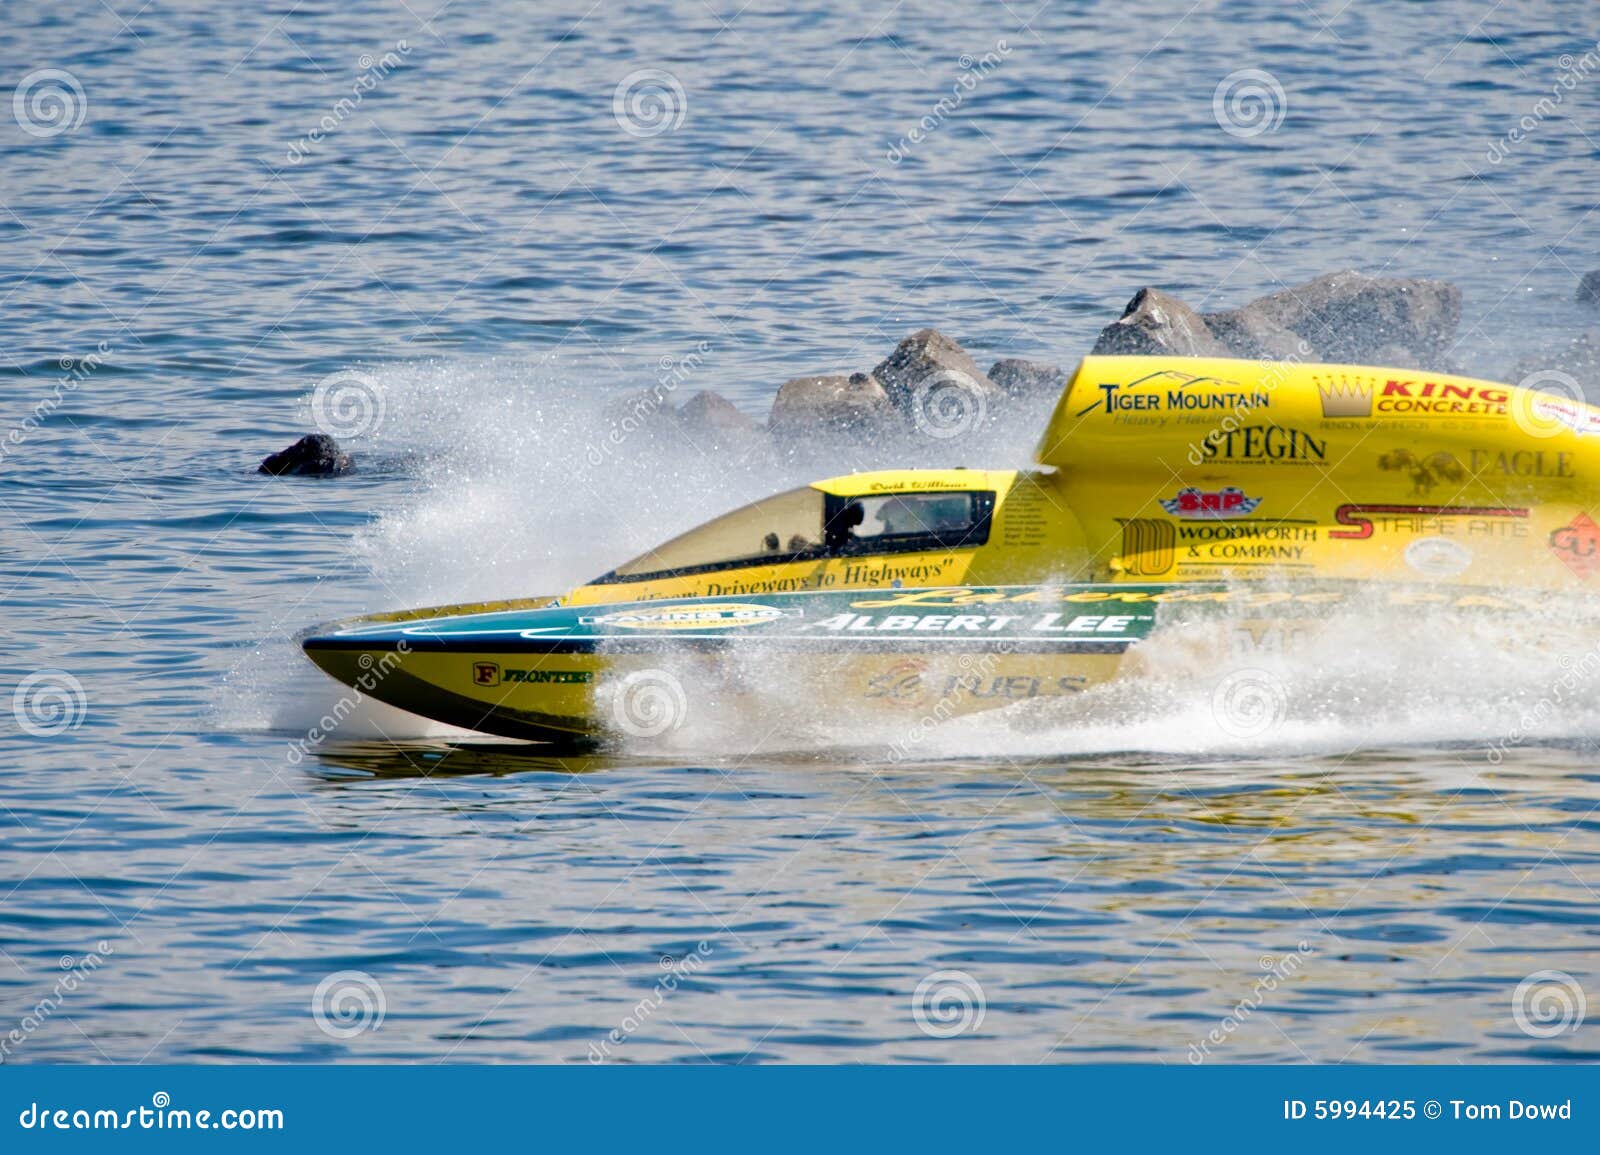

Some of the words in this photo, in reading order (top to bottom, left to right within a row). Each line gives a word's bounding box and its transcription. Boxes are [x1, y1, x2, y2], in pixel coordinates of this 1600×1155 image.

[1099, 384, 1160, 413] TIGER
[1168, 391, 1269, 410] MOUNTAIN
[1381, 379, 1509, 402] KING
[1377, 399, 1508, 415] CONCRETE
[1202, 424, 1327, 459] STEGIN
[1470, 447, 1576, 477] EAGLE
[1179, 526, 1317, 541] WOODWORTH
[1187, 544, 1200, 557] &
[1209, 544, 1304, 559] COMPANY
[706, 574, 809, 597] Driveways
[817, 574, 835, 587] to
[844, 559, 953, 586] Highways"
[812, 613, 1022, 632] ALBERT
[476, 665, 497, 683] F
[942, 676, 1087, 698] FUELS
